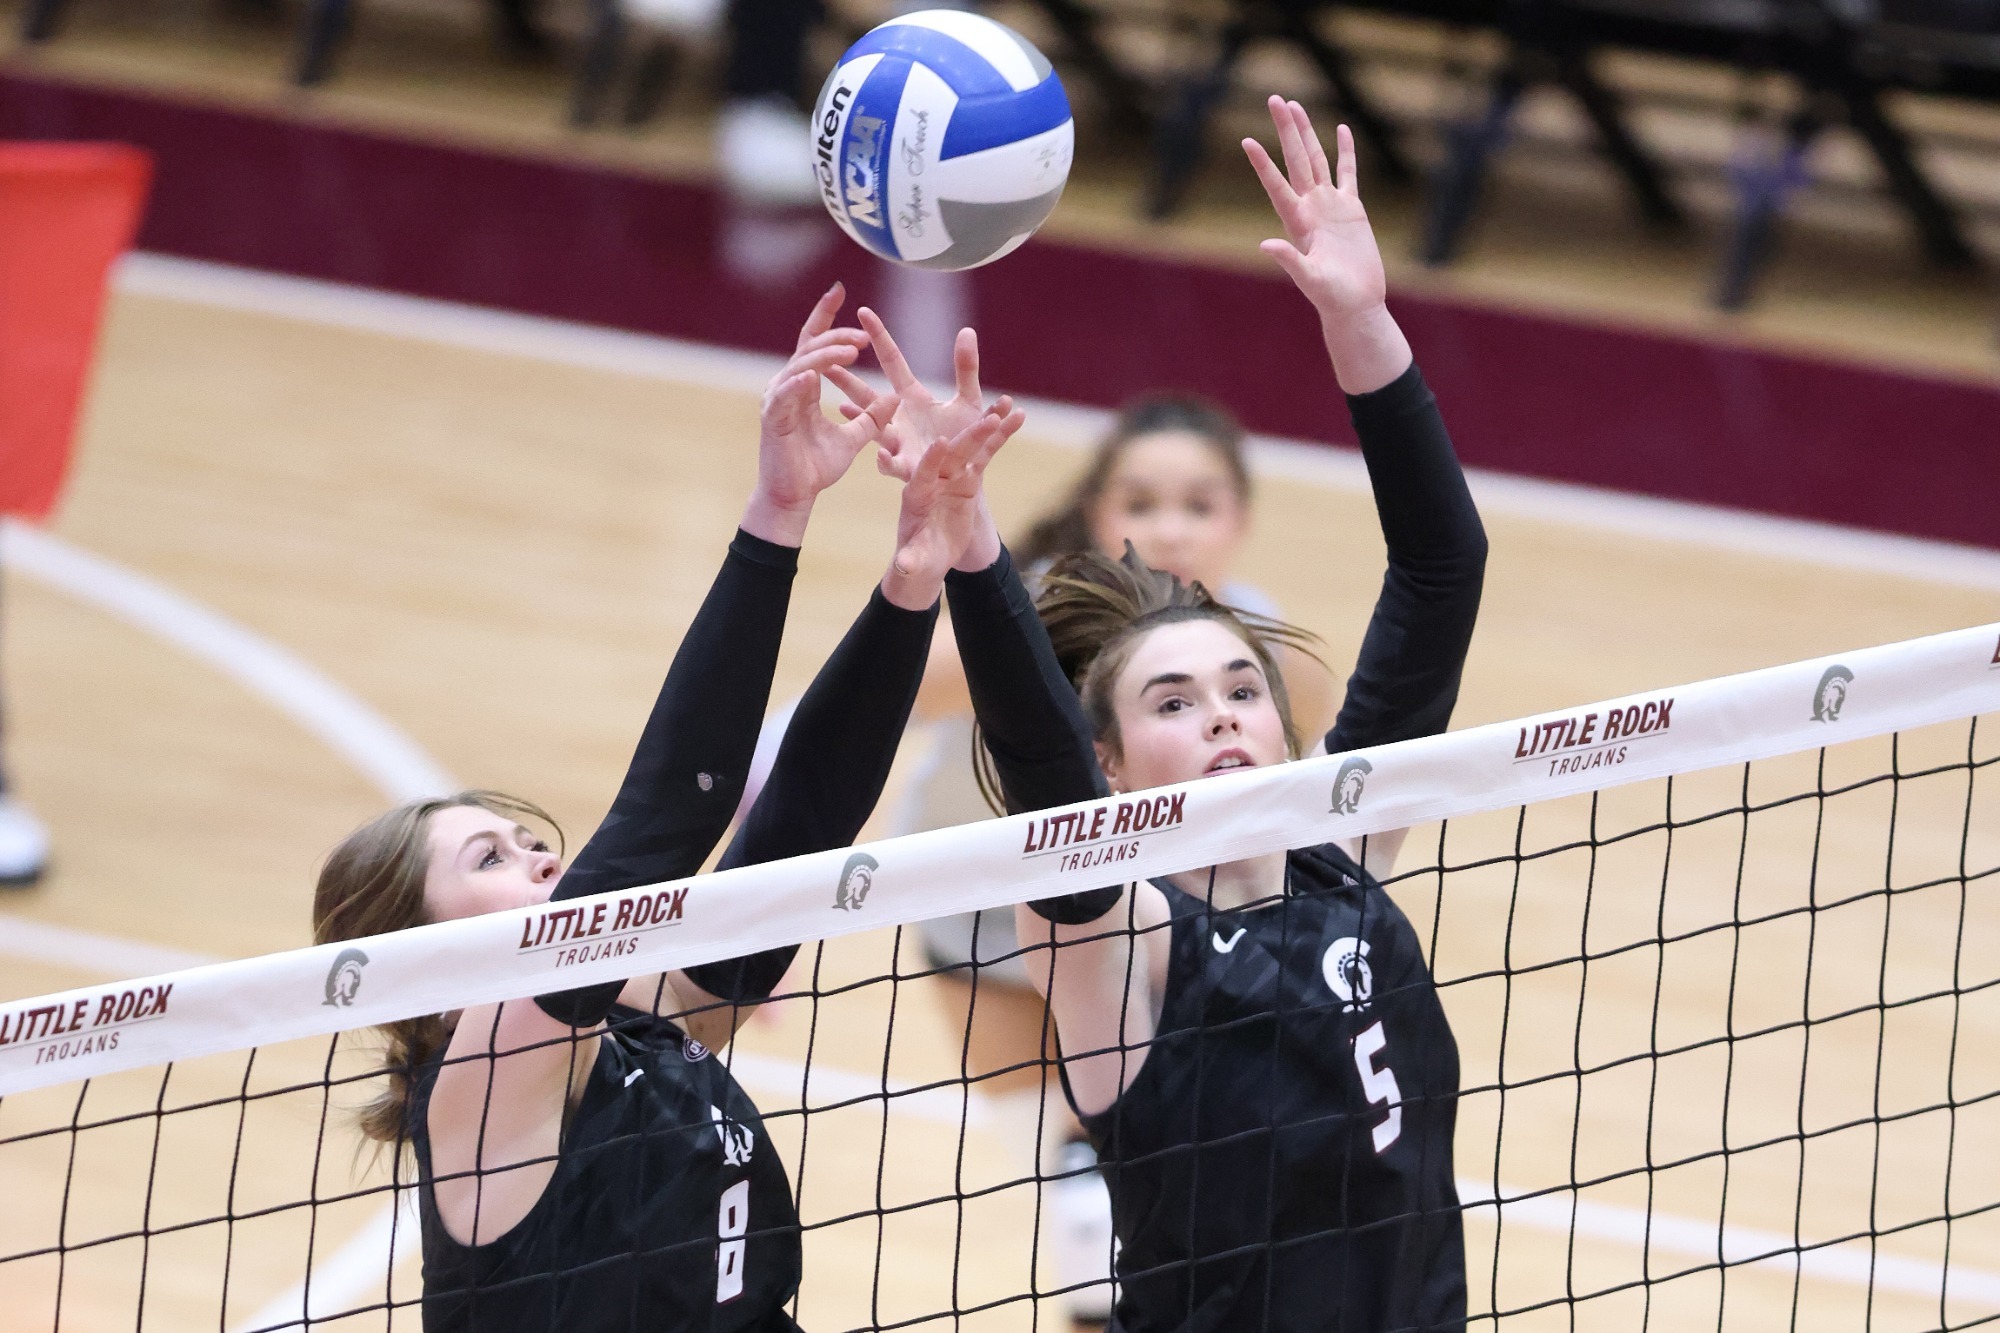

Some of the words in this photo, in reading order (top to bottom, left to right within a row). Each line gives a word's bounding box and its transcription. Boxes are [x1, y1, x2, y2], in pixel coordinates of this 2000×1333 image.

[817, 85, 852, 225] molten
[845, 114, 884, 230] NCAA
[1514, 712, 1598, 759] LITTLE
[1602, 697, 1675, 741] ROCK
[1548, 746, 1628, 777] TROJANS
[1023, 806, 1107, 853] LITTLE
[1111, 791, 1187, 836] ROCK
[1060, 841, 1140, 872] TROJANS
[519, 903, 608, 949] LITTLE
[611, 887, 689, 932] ROCK
[555, 937, 639, 968] TROJANS
[0, 998, 89, 1045] LITTLE
[93, 983, 174, 1026] ROCK
[35, 1031, 121, 1065] TROJANS
[1352, 1020, 1402, 1154] 5
[715, 1178, 750, 1304] 8
